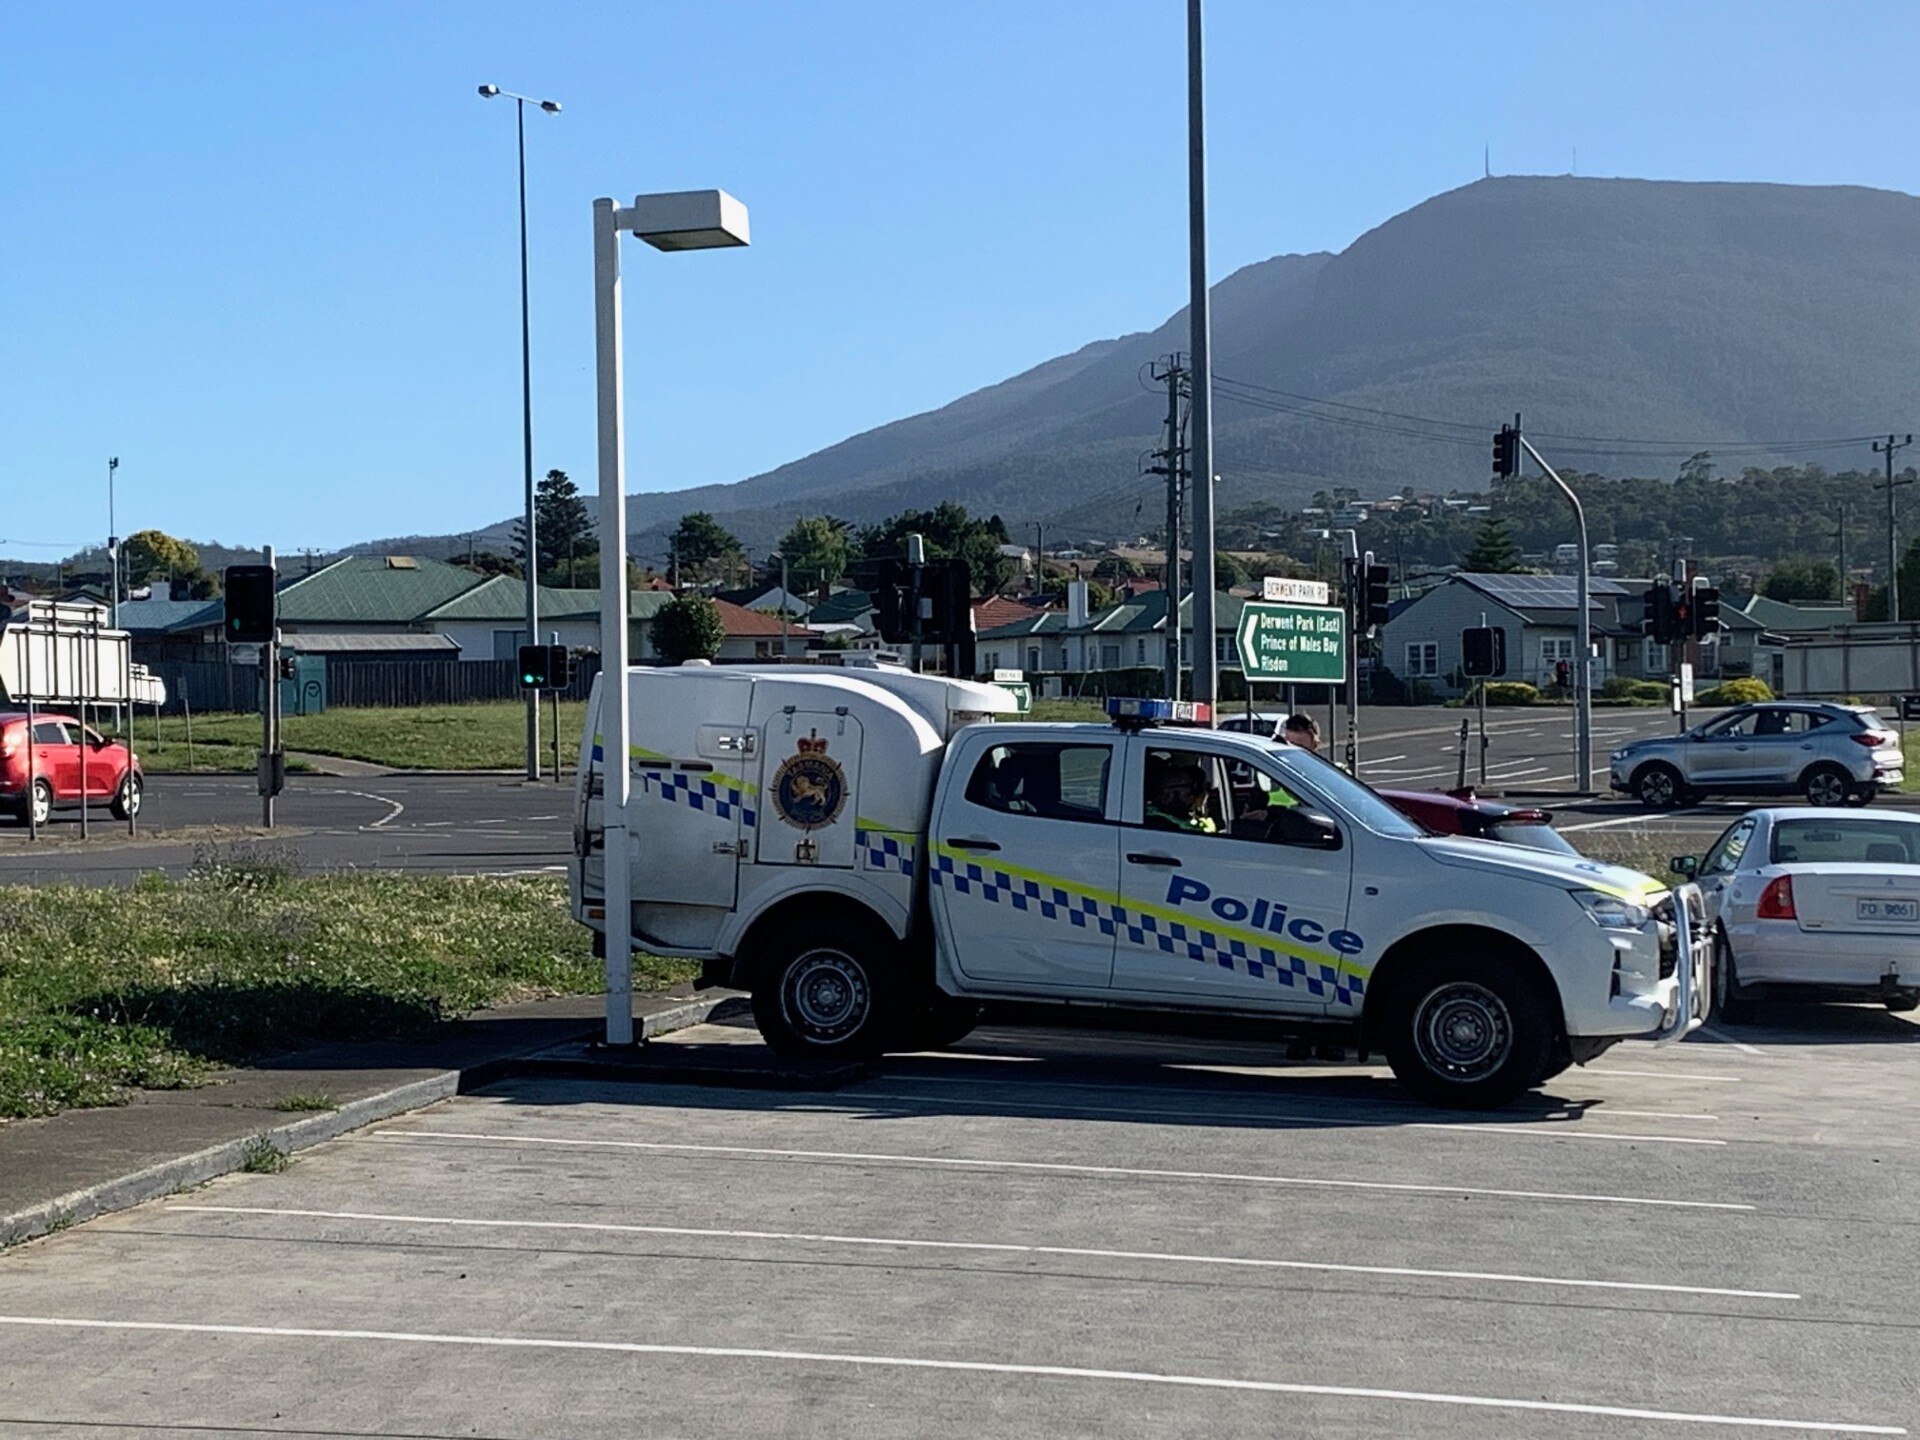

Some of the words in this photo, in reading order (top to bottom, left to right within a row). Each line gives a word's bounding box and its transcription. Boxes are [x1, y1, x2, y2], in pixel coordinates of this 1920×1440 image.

[1266, 581, 1297, 597] DERWENT
[1298, 585, 1316, 598] PARK
[1261, 612, 1294, 630] Derwent
[1296, 614, 1314, 631] Park
[1316, 615, 1340, 634] (East)
[1261, 633, 1287, 650] Prince
[1288, 635, 1298, 651] of
[1300, 636, 1321, 652] Wales
[1323, 636, 1339, 657] Bay
[1261, 655, 1288, 672] Risdon
[1166, 874, 1364, 955] Police
